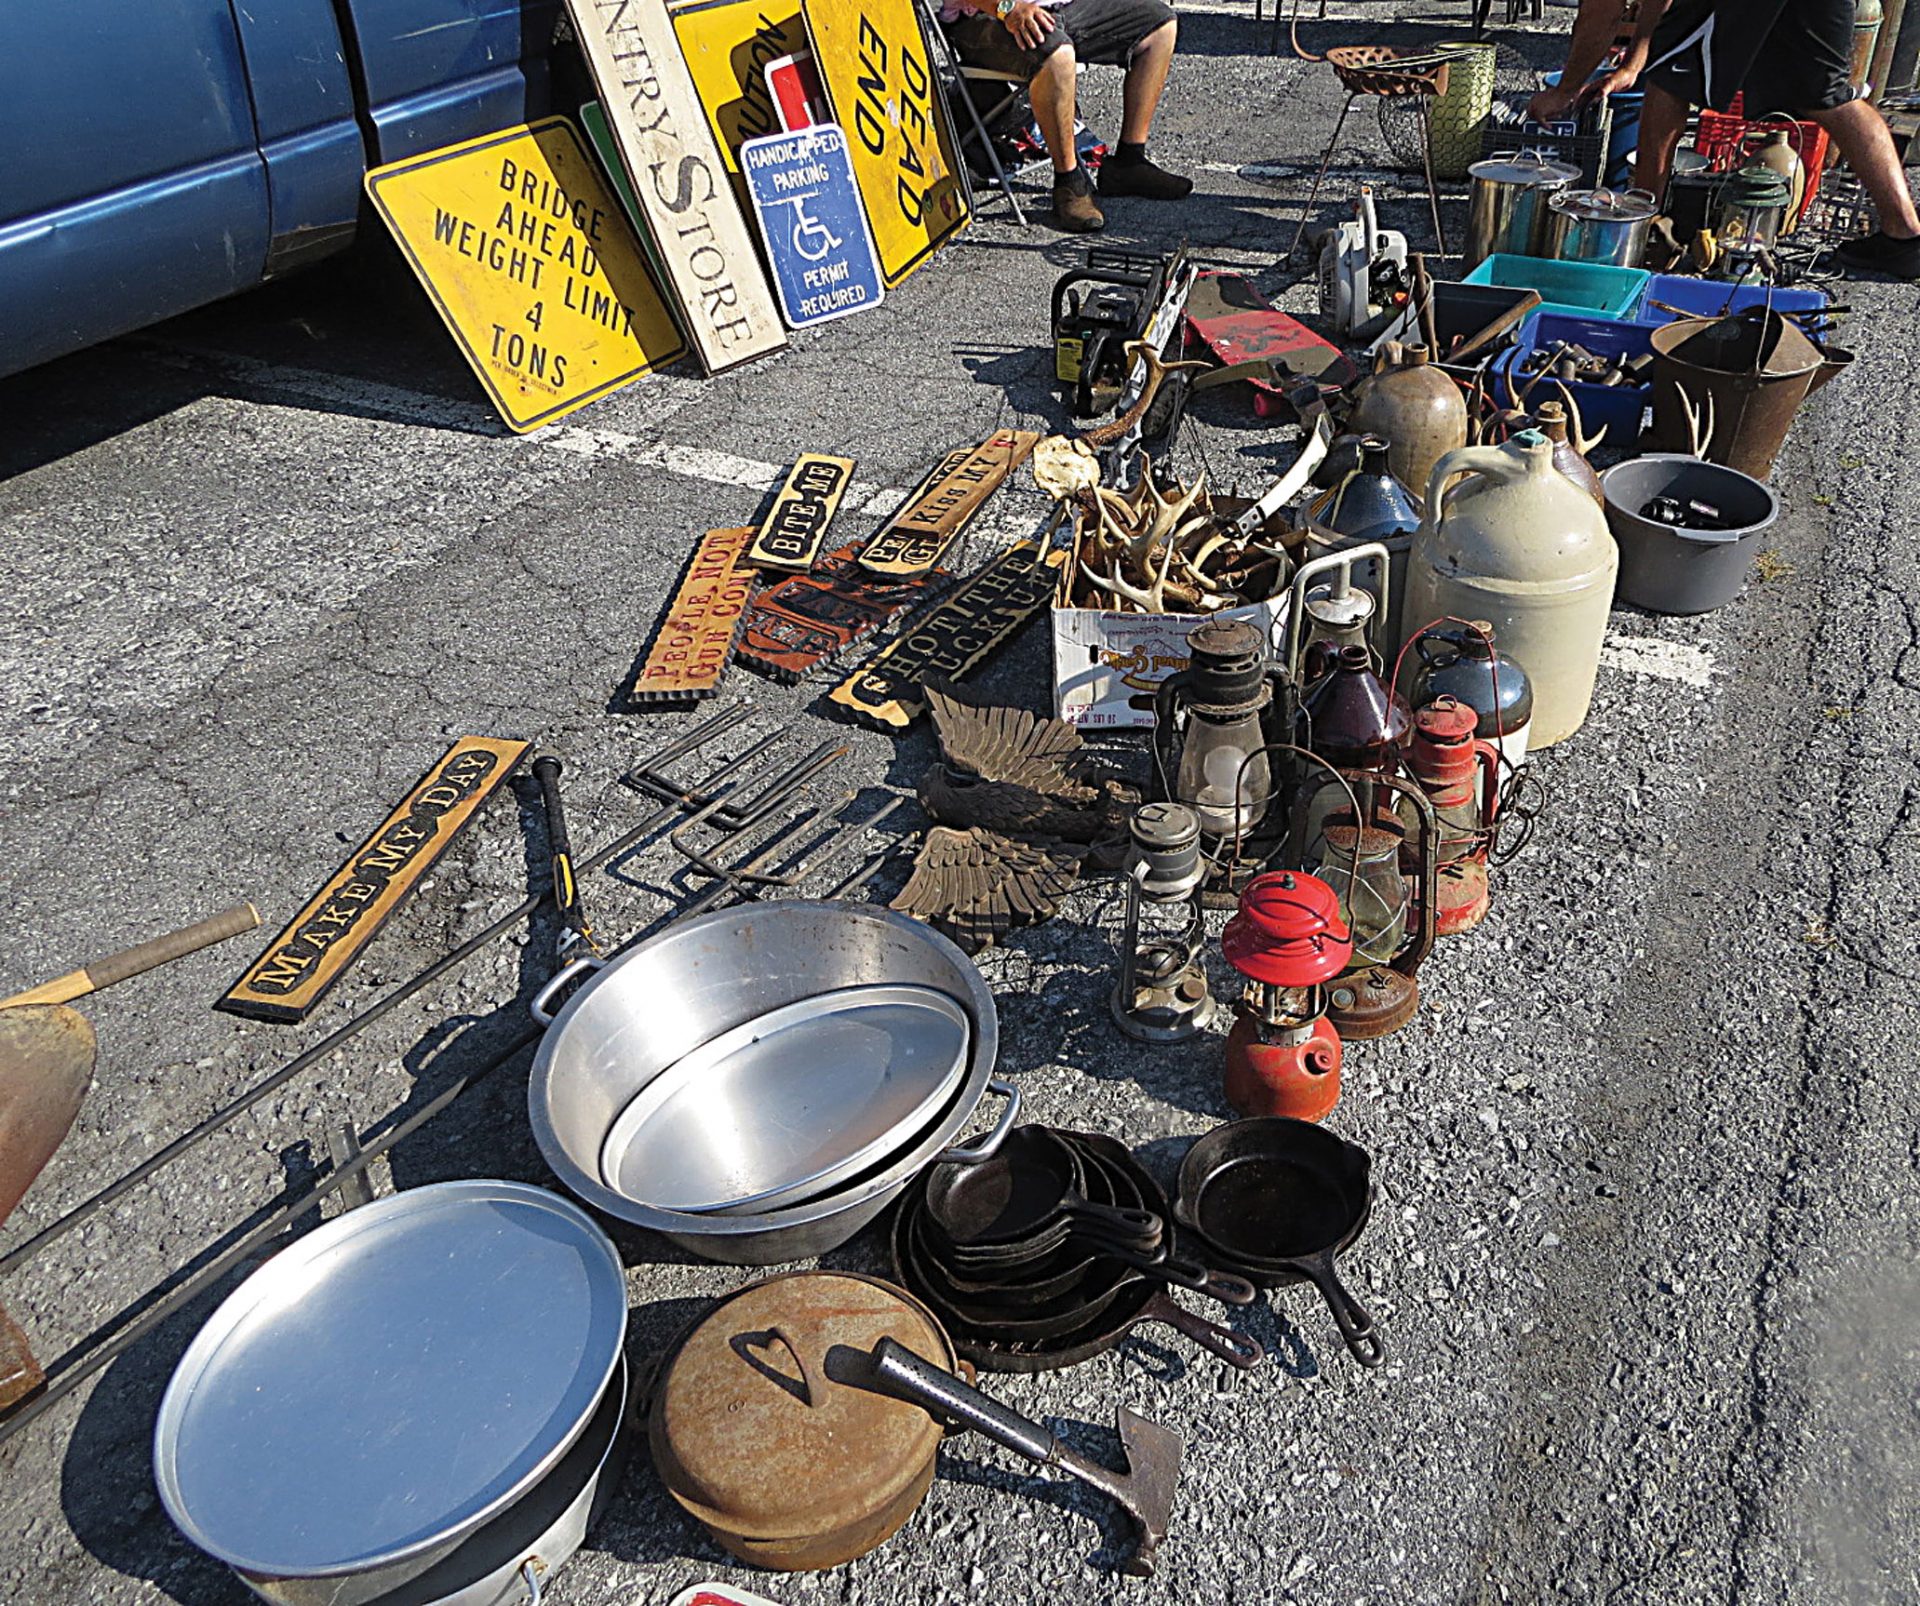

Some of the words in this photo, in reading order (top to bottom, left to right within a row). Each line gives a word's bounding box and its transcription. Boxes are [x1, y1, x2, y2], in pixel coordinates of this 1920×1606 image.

[735, 12, 790, 143] AUTION
[856, 12, 888, 156] END
[747, 132, 843, 170] HANDICAPPED
[896, 45, 932, 228] DEAD
[500, 158, 606, 242] BRIDGE
[594, 0, 678, 142] NTRY
[650, 153, 756, 351] STORE
[772, 164, 830, 192] PARKING
[495, 200, 597, 277] AHEAD
[434, 207, 543, 291] WEIGHT
[563, 275, 636, 339] LIMIT
[800, 285, 867, 317] REQUIRED
[802, 260, 850, 290] PERMIT
[526, 302, 543, 331] 4
[491, 323, 567, 388] TONS
[966, 455, 999, 493] MY
[770, 499, 817, 555] BITE
[811, 463, 841, 492] ME
[693, 533, 742, 583] NOT
[966, 557, 1033, 620] THE
[1005, 565, 1058, 616] UP
[686, 627, 729, 680] GUN
[252, 882, 378, 989] MAKE
[360, 823, 427, 872] MY
[418, 754, 490, 809] DAY
